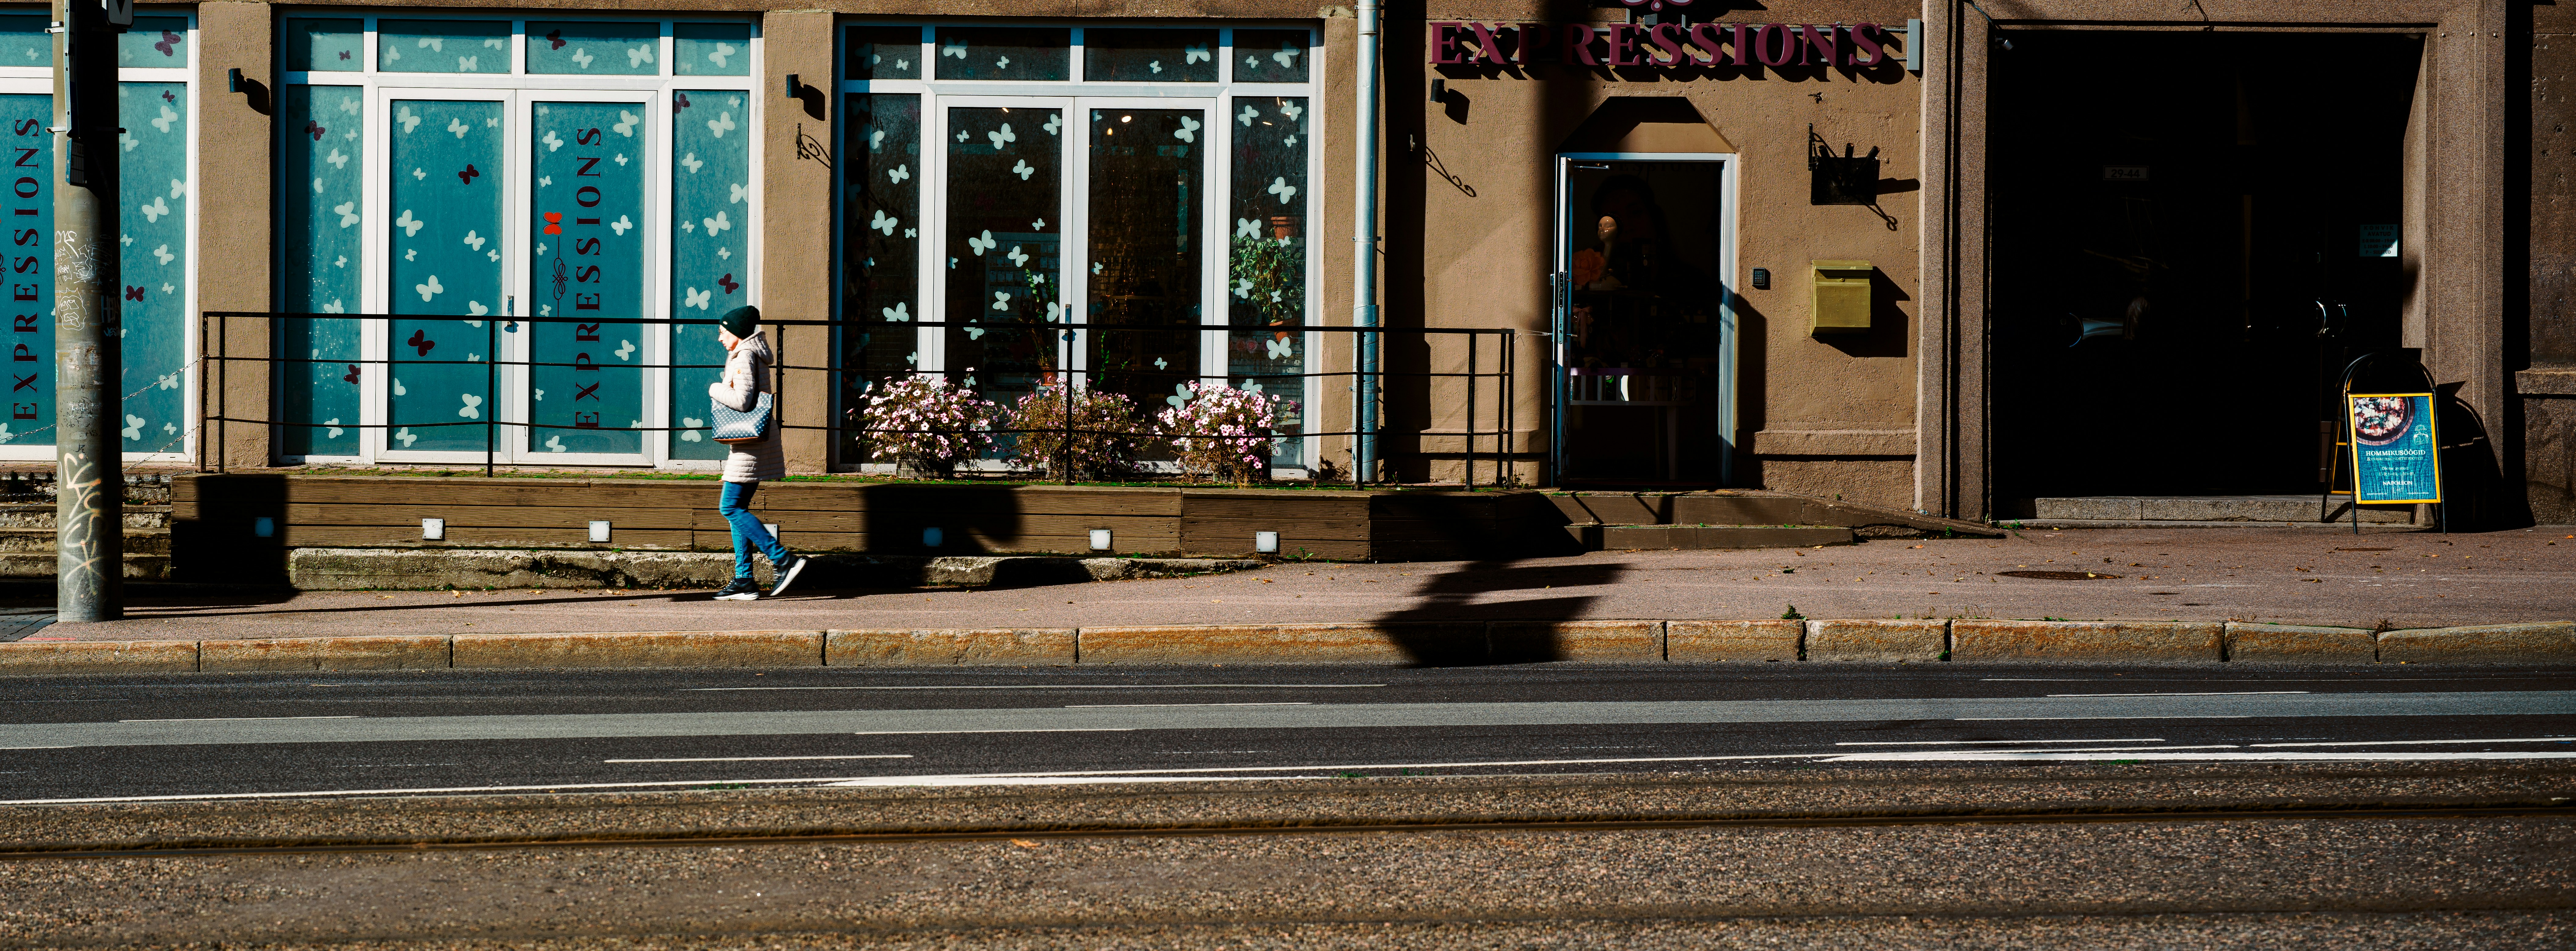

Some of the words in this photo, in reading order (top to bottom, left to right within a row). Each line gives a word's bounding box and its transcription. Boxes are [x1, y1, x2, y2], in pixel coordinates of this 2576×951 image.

[1429, 21, 1883, 67] EXPRESSIONS
[2111, 169, 2140, 178] 29-44
[13, 118, 40, 422] EXPRESSIONS
[575, 127, 602, 430] EXPRESSIONS
